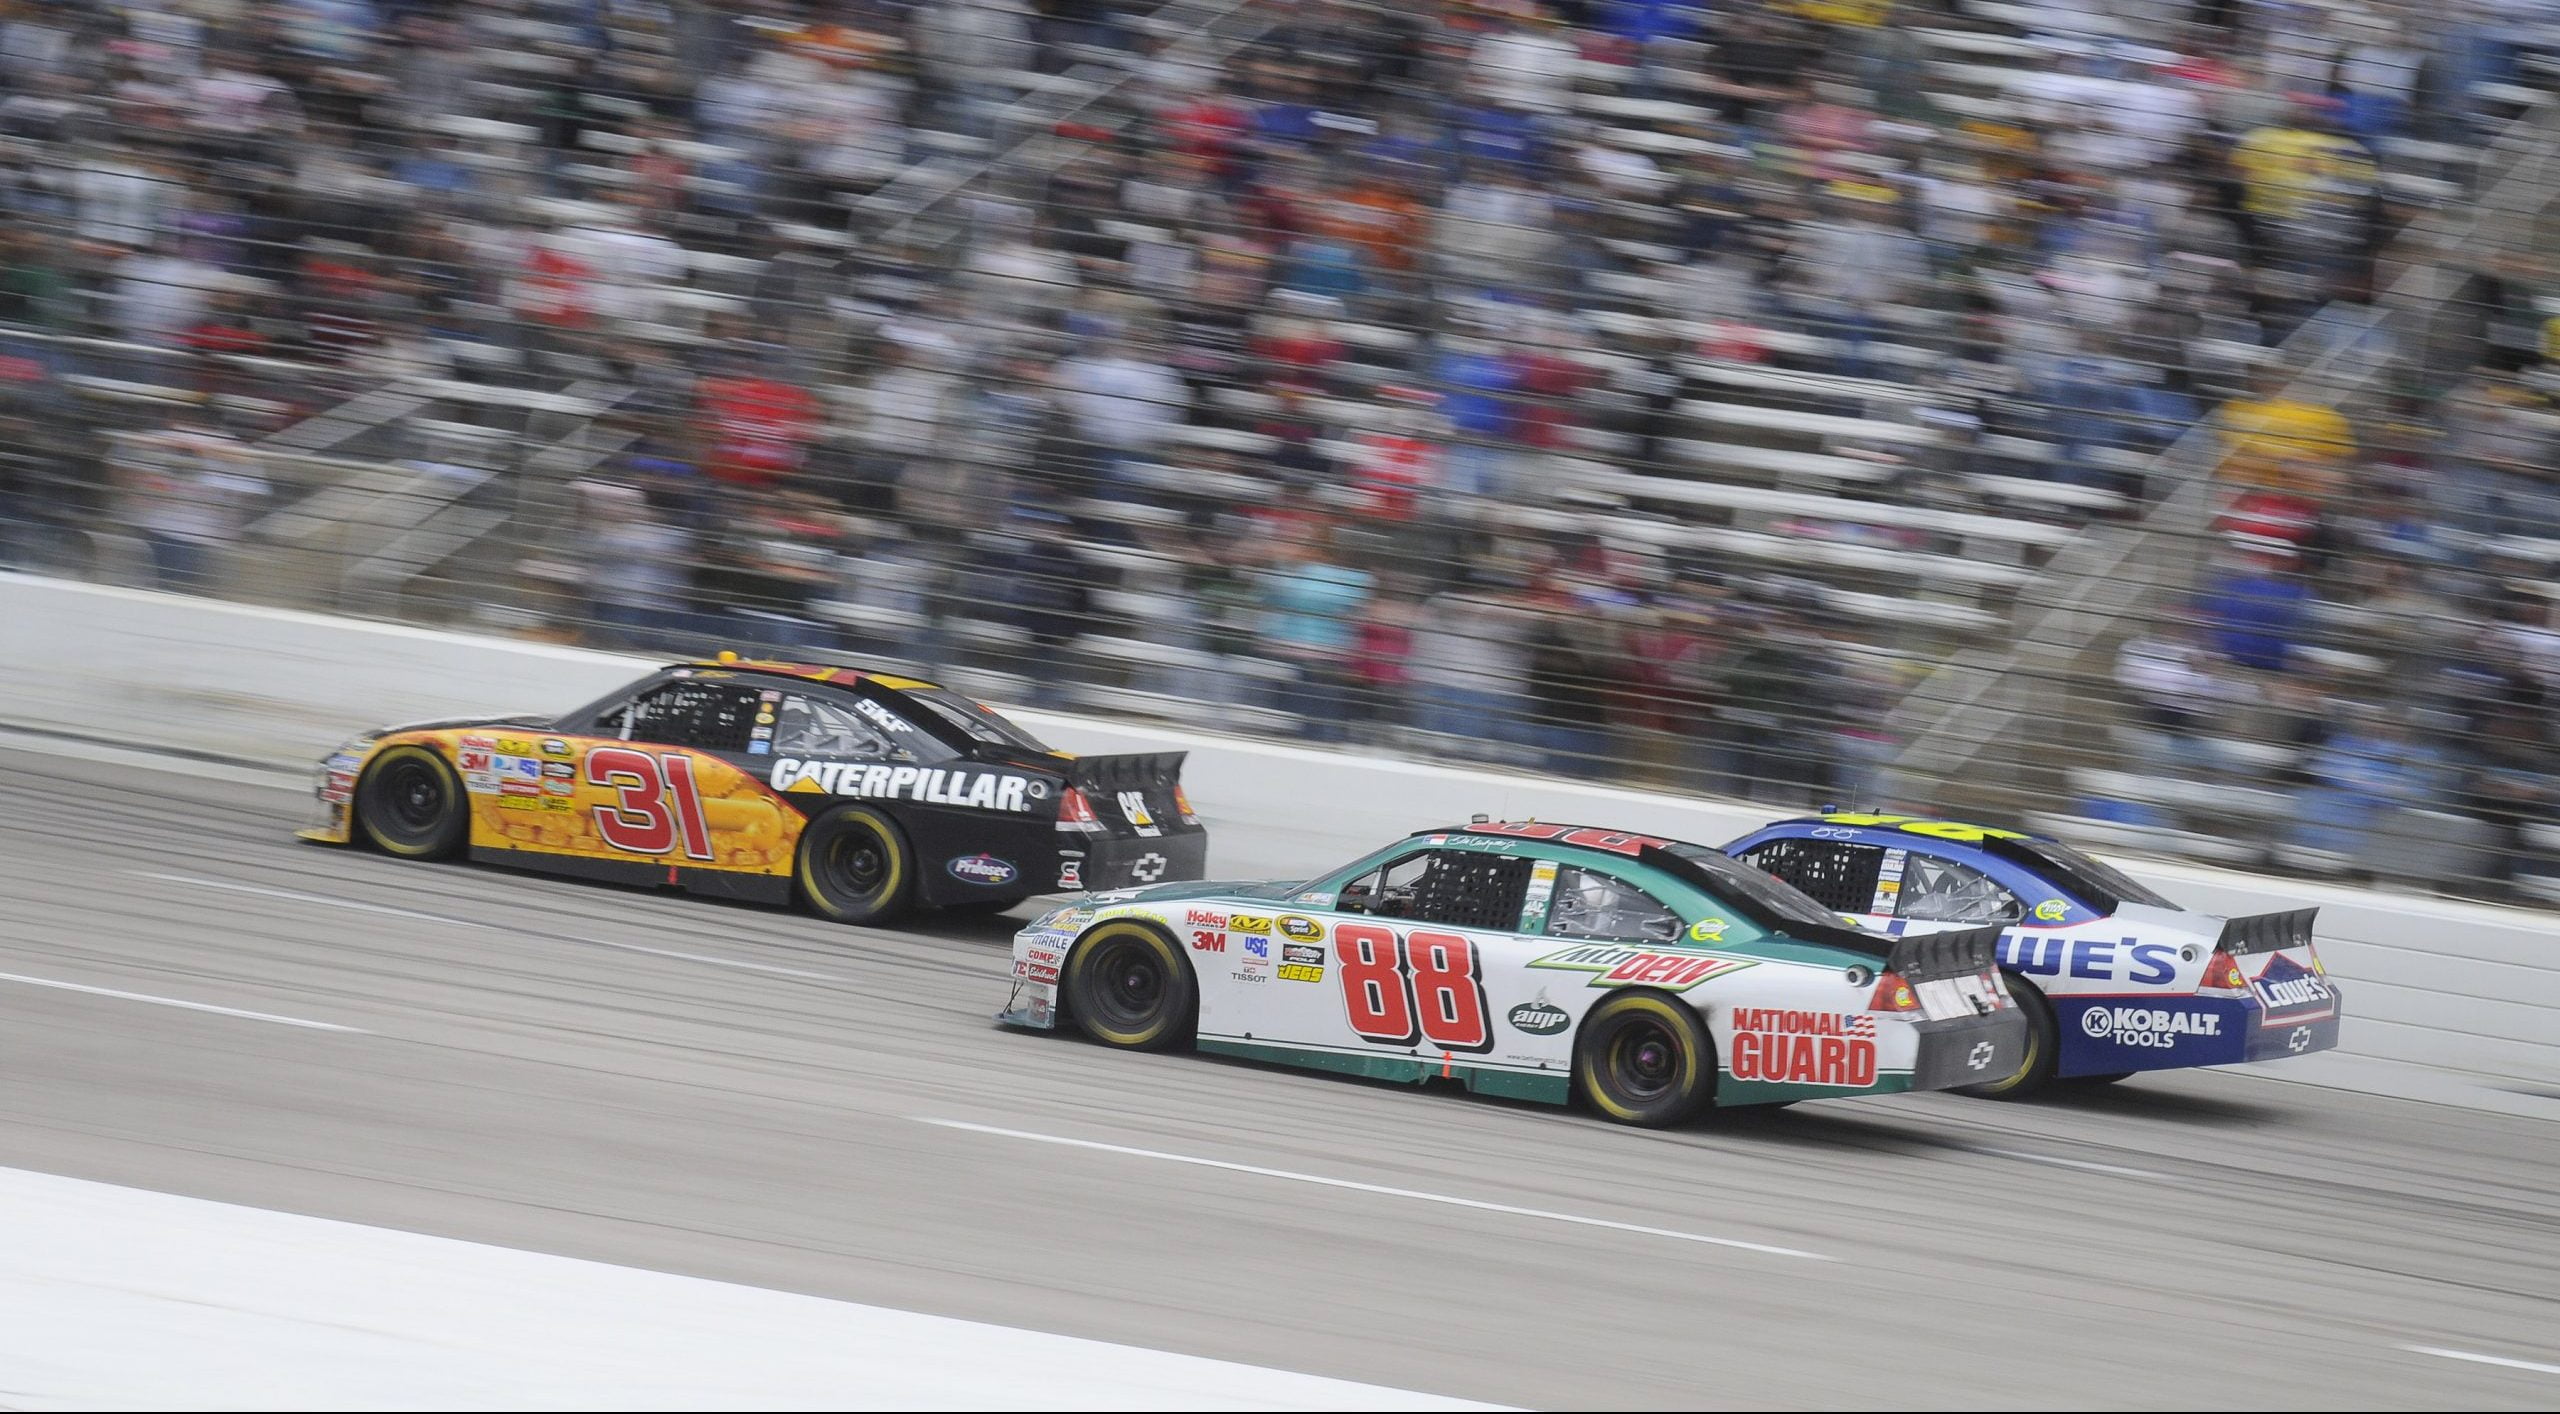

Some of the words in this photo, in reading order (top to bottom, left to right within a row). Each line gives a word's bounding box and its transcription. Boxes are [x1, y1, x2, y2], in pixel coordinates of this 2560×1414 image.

[854, 698, 914, 733] SKF
[770, 758, 1029, 812] CATERPILLAR
[585, 747, 714, 860] 31
[1117, 791, 1154, 825] CAT
[1187, 910, 1227, 929] Holley
[1032, 935, 1068, 950] MAHLE
[1192, 931, 1226, 952] 3M
[1245, 936, 1268, 957] USG
[1278, 964, 1324, 983] JEGS
[1996, 934, 2177, 985] WE'S
[1232, 972, 1267, 983] TISSOT
[1332, 922, 1491, 1052] 88
[2253, 974, 2328, 1008] LOWE'S
[1512, 1010, 1567, 1029] amp
[1733, 1008, 1846, 1036] NATIONAL
[2114, 1008, 2220, 1036] KOBALT
[2113, 1030, 2174, 1048] TOOLS
[1732, 1032, 1876, 1086] GUARD
